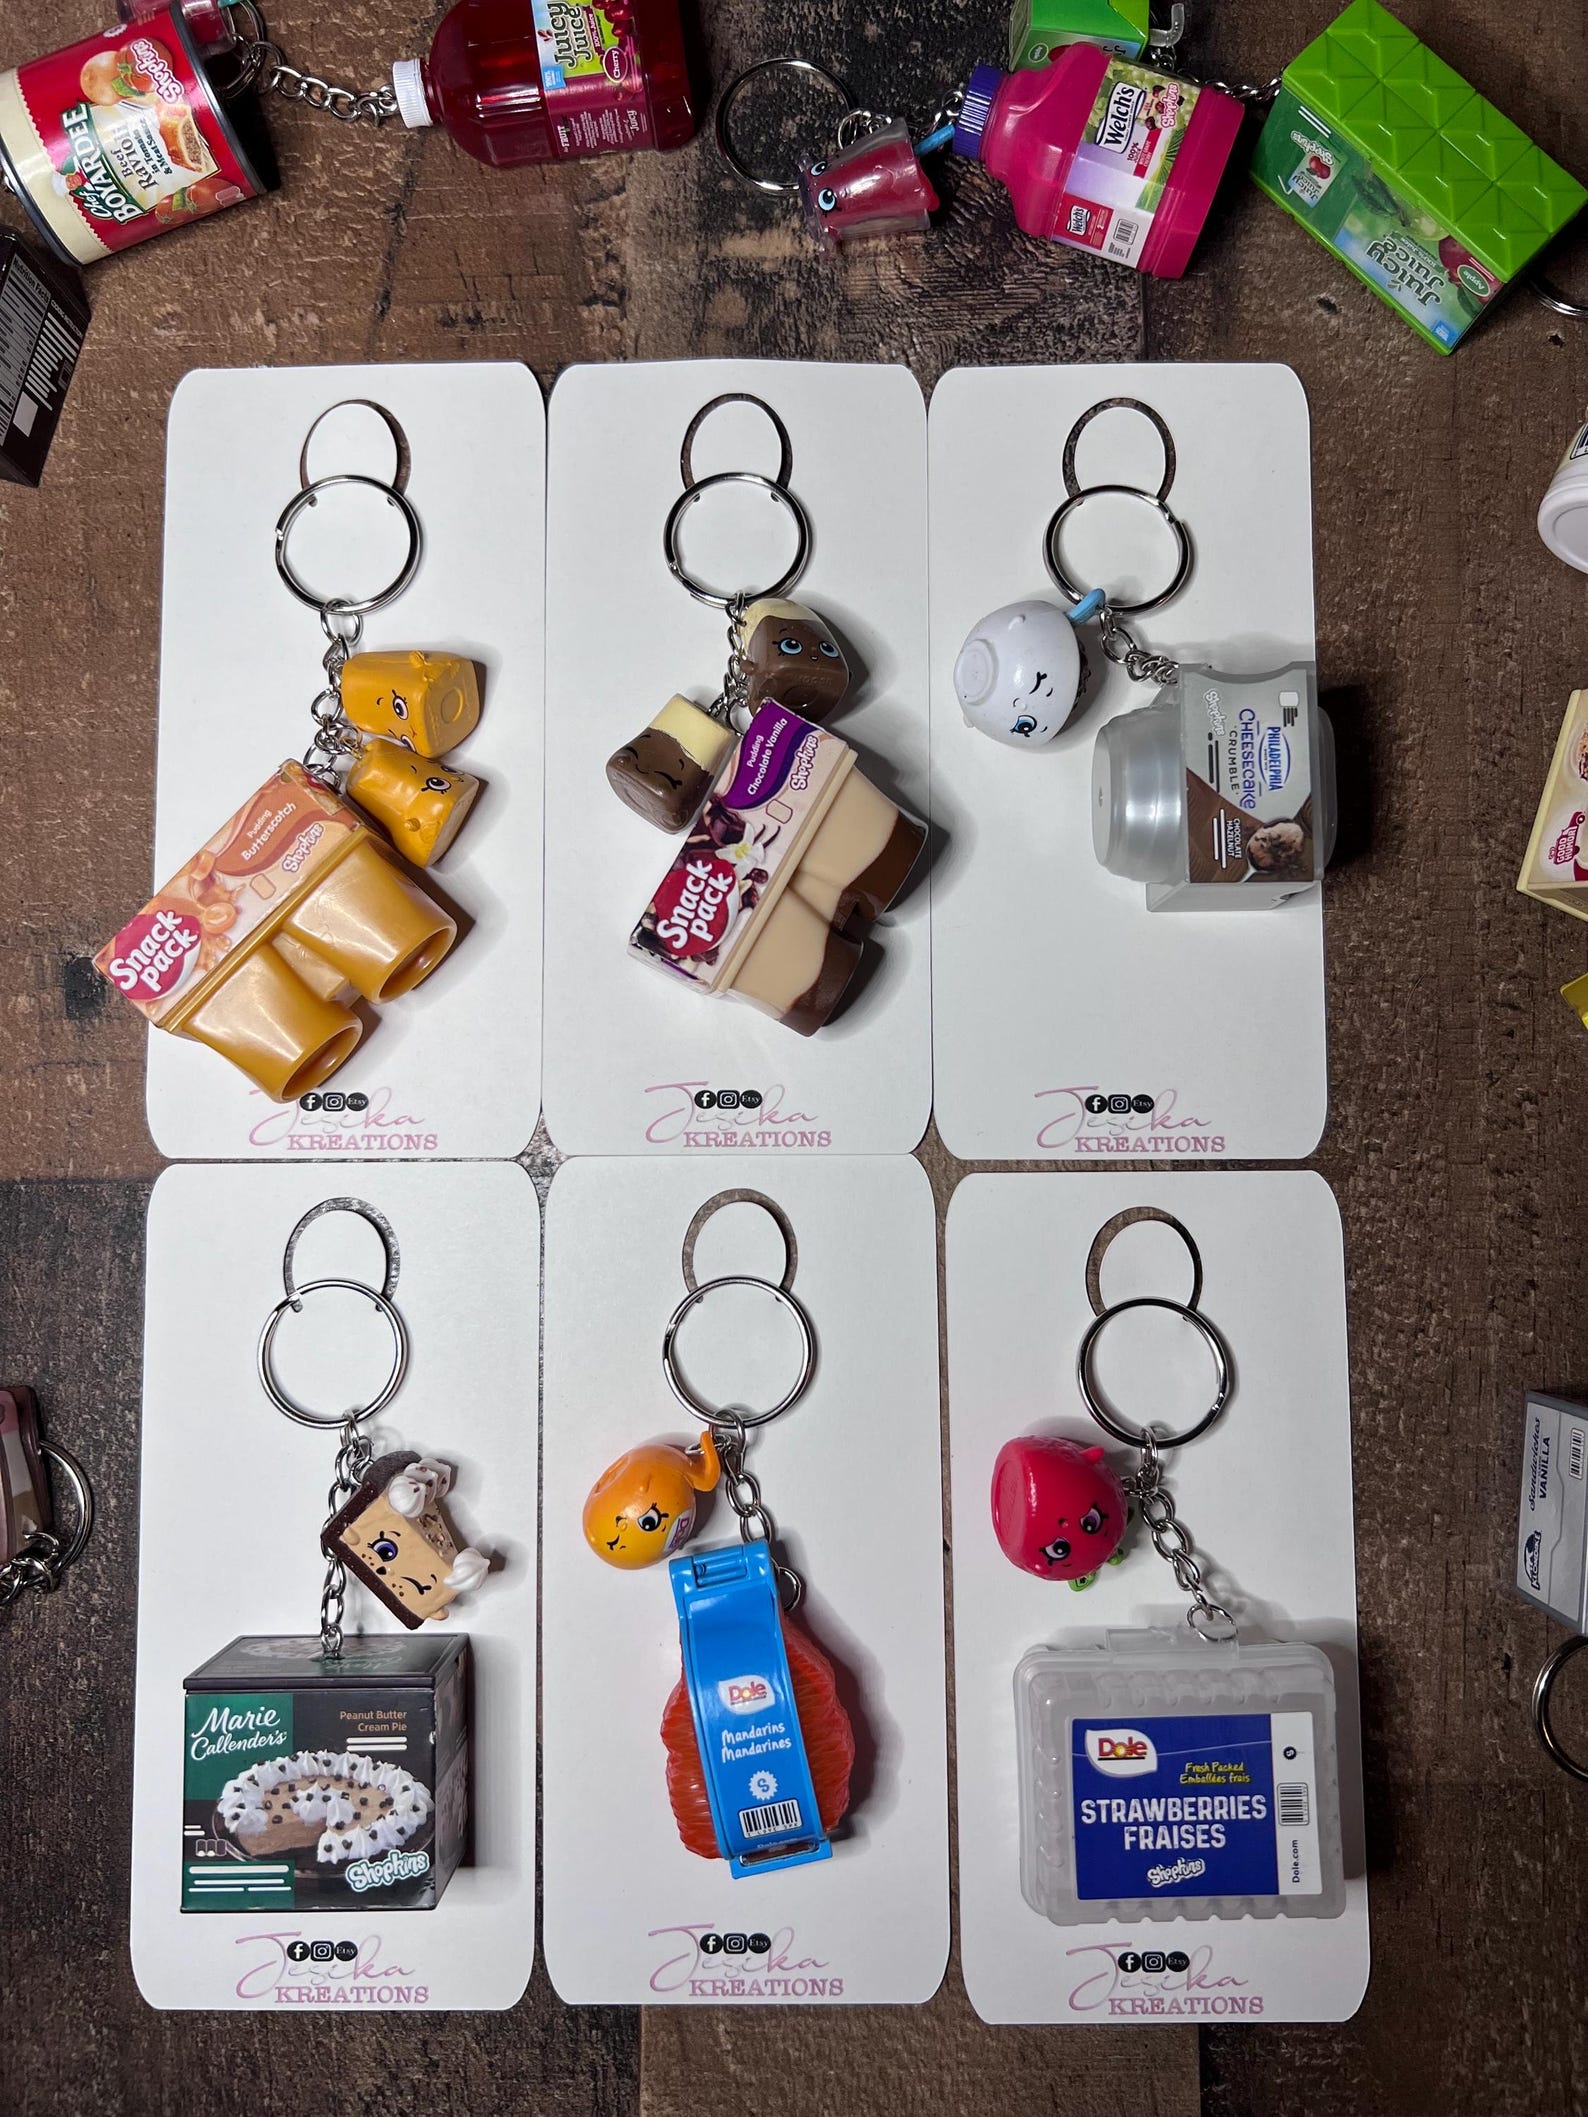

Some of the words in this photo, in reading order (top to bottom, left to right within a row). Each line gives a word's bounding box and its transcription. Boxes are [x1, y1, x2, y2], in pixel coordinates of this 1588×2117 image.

[547, 0, 577, 69] Juicy
[567, 6, 593, 61] Juice
[131, 39, 184, 103] Shopkins
[612, 50, 621, 78] Cherry
[1104, 86, 1135, 146] Welch's
[1161, 83, 1180, 128] Shopkins
[63, 103, 142, 223] BOYARDEE
[110, 149, 131, 178] Beef
[1127, 141, 1139, 162] 100%
[80, 190, 112, 218] Chef
[1072, 207, 1086, 233] Welch's
[1366, 240, 1440, 307] Juicy
[1382, 238, 1445, 291] Juice
[1464, 268, 1487, 290] Apple
[747, 734, 764, 767] Pudding
[747, 748, 771, 796] Chocolate
[766, 717, 788, 750] Vanilla
[790, 735, 819, 790] Shopkins
[1229, 730, 1240, 791] CRUMBLE
[1267, 726, 1284, 792] PHILADELPHIA
[240, 801, 297, 861] Butterscotch
[247, 809, 272, 838] Pudding
[1226, 820, 1235, 857] HAZELNUT
[1234, 818, 1242, 859] CHOCOLATE
[282, 823, 324, 873] Shopkins
[1556, 837, 1567, 863] GOOD
[656, 860, 714, 949] Snack
[689, 872, 733, 943] pack
[109, 910, 183, 990] Snack
[140, 928, 198, 992] pack
[287, 1134, 438, 1151] KREATIONS
[683, 1131, 831, 1147] KREATIONS
[1075, 1136, 1225, 1153] KREATIONS
[1529, 1417, 1541, 1512] Sandwiches
[1539, 1437, 1551, 1499] VANILLA
[728, 1681, 767, 1701] Dole
[191, 1706, 280, 1737] Marie
[340, 1710, 374, 1720] Peanut
[376, 1710, 407, 1720] Butter
[358, 1722, 389, 1732] Cream
[391, 1722, 407, 1731] Pie
[190, 1730, 287, 1760] Callender's
[721, 1722, 785, 1746] Mandarins
[1098, 1737, 1147, 1759] Dole
[721, 1737, 792, 1763] Mandarines
[1185, 1762, 1210, 1773] Fresh
[1212, 1762, 1245, 1772] Packed
[1228, 1773, 1250, 1783] frais
[757, 1778, 770, 1793] S
[1081, 1795, 1267, 1824] STRAWBERRIES
[1124, 1824, 1226, 1850] FRAISES
[345, 1850, 429, 1891] Shopkins
[1147, 1856, 1205, 1888] Shopkins
[1292, 1840, 1300, 1883] Dole.com
[275, 1986, 428, 2003] KREATIONS
[689, 1979, 844, 1996] KREATIONS
[1109, 1997, 1264, 2015] KREATIONS
